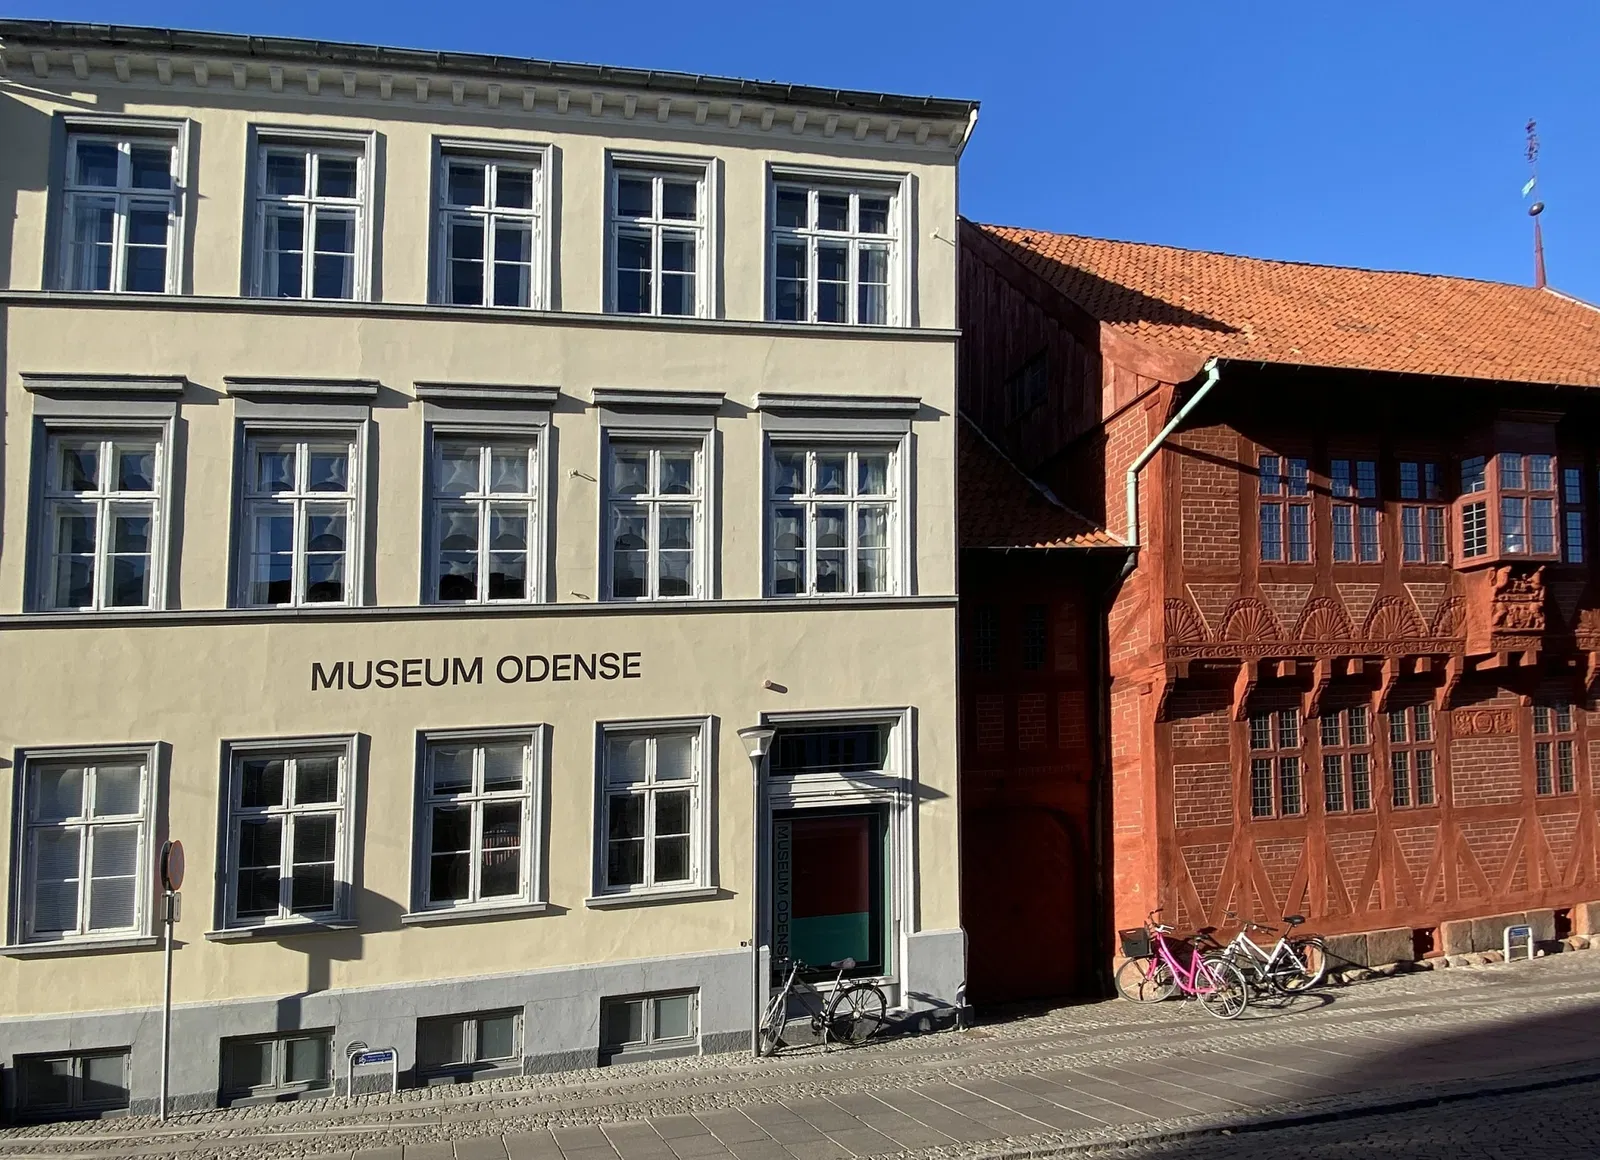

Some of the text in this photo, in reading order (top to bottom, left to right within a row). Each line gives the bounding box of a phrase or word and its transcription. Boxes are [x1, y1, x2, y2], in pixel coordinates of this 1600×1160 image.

[311, 652, 641, 691] MUSEUM ODENSE
[777, 826, 789, 895] MUSEUM
